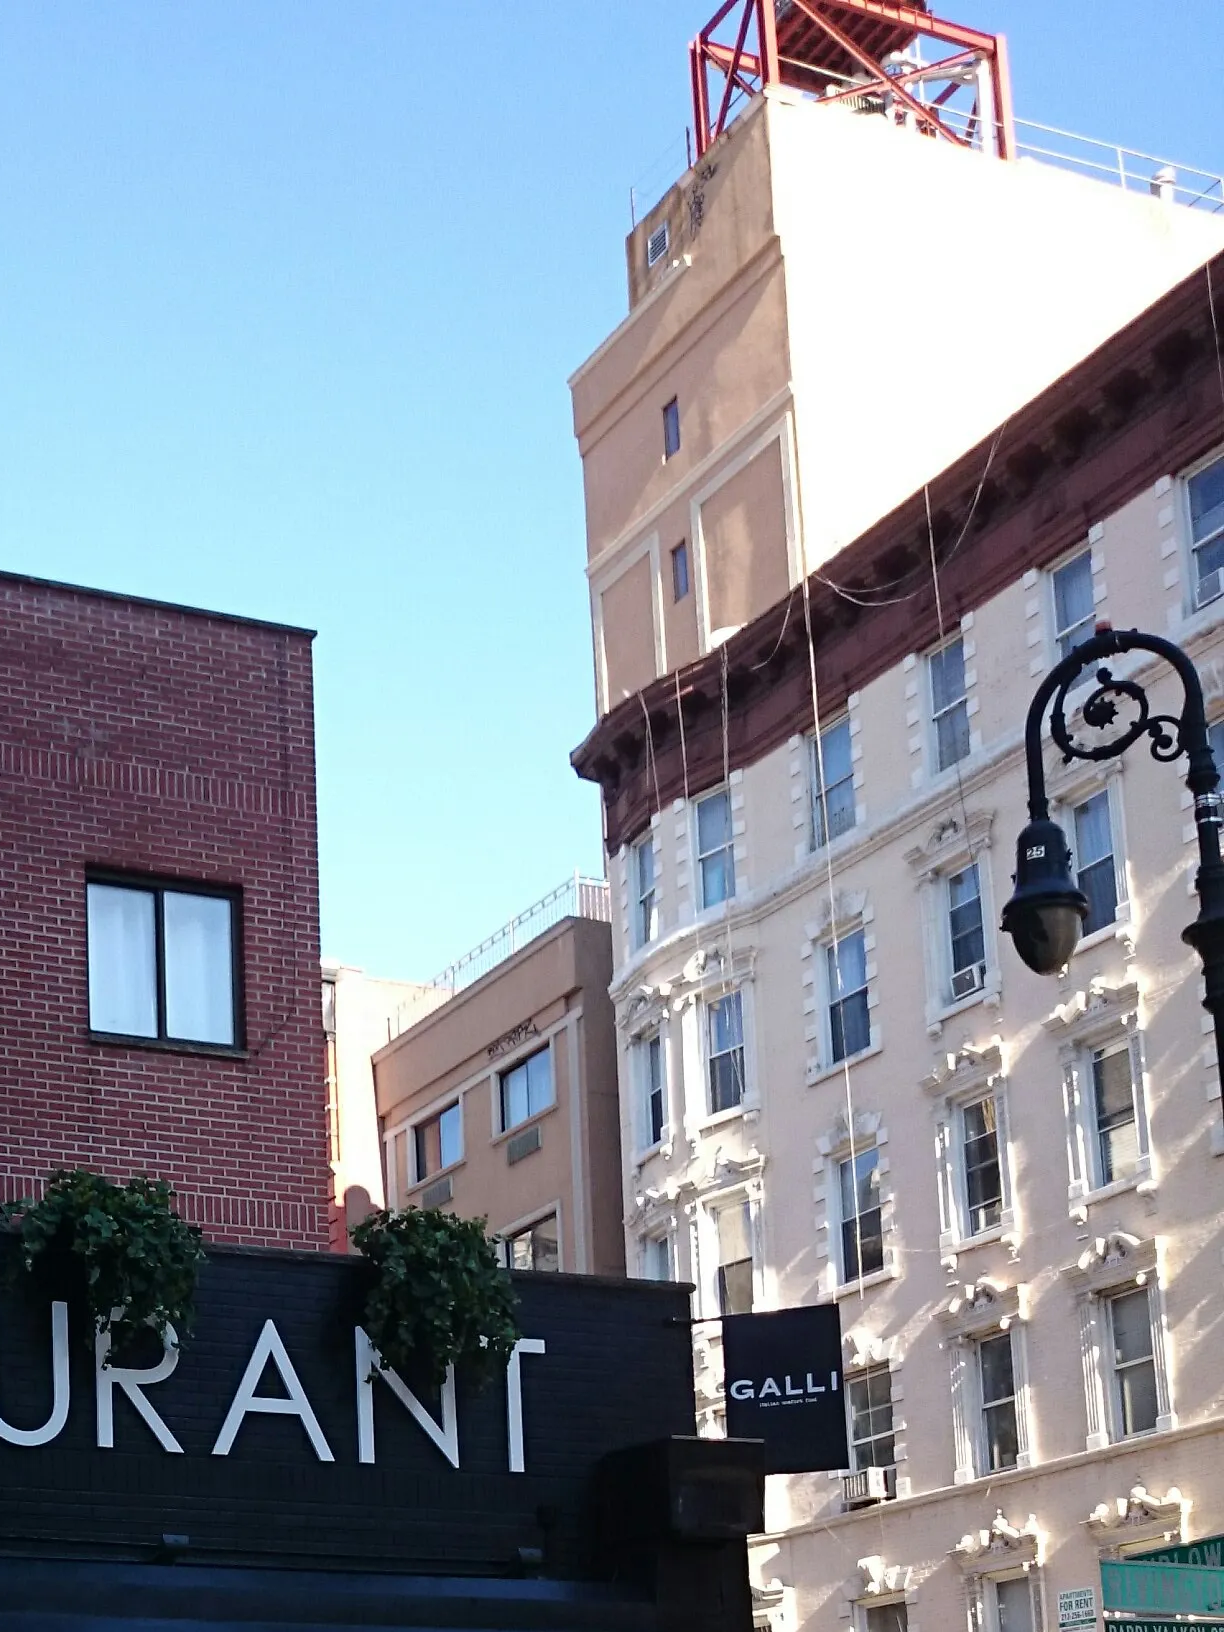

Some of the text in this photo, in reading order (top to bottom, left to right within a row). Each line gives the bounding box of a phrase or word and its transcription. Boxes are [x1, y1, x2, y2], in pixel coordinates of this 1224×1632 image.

[1027, 846, 1043, 858] 25
[730, 1371, 838, 1400] GALLI
[1059, 1597, 1093, 1611] FOR RENT
